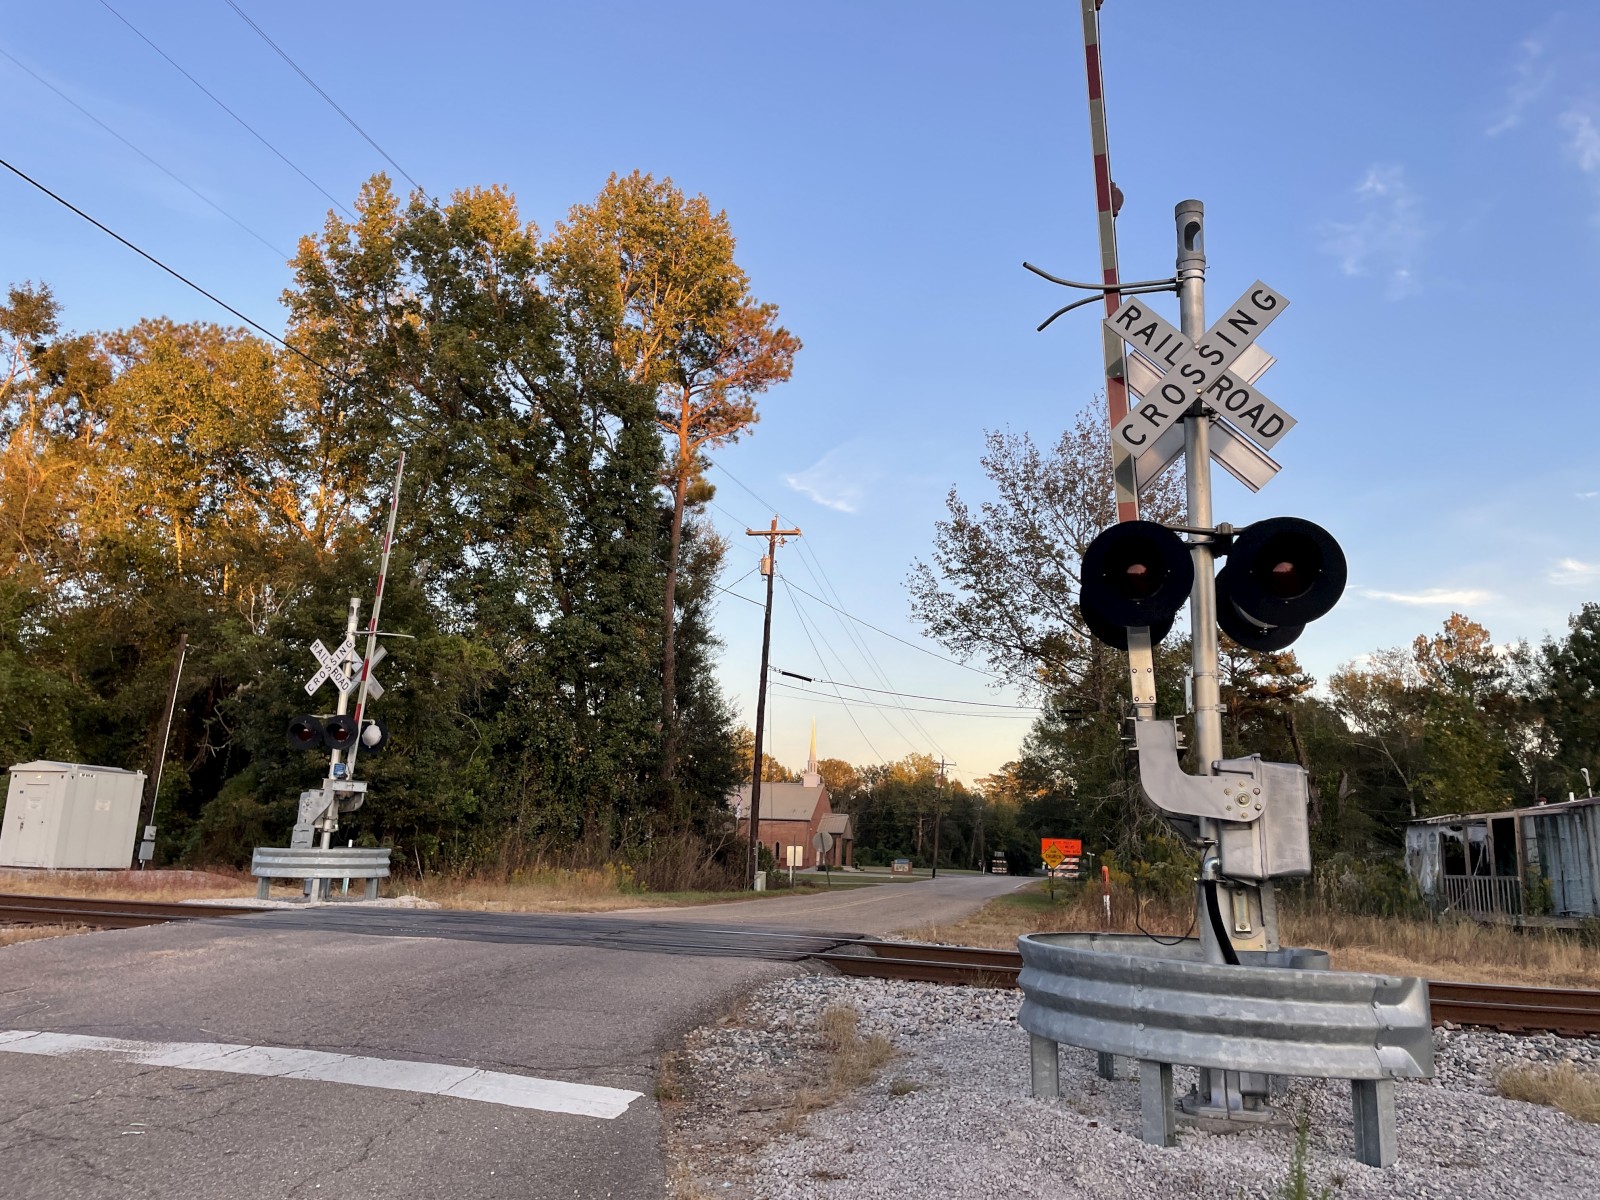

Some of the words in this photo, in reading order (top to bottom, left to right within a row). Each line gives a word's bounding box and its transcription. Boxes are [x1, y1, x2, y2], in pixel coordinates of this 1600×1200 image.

[1115, 304, 1184, 367] RAIL
[1206, 374, 1284, 438] ROAD
[1121, 289, 1277, 446] CROSSING
[307, 640, 353, 692] CROSSING
[312, 642, 329, 665] RAIL
[331, 667, 349, 691] ROAD
